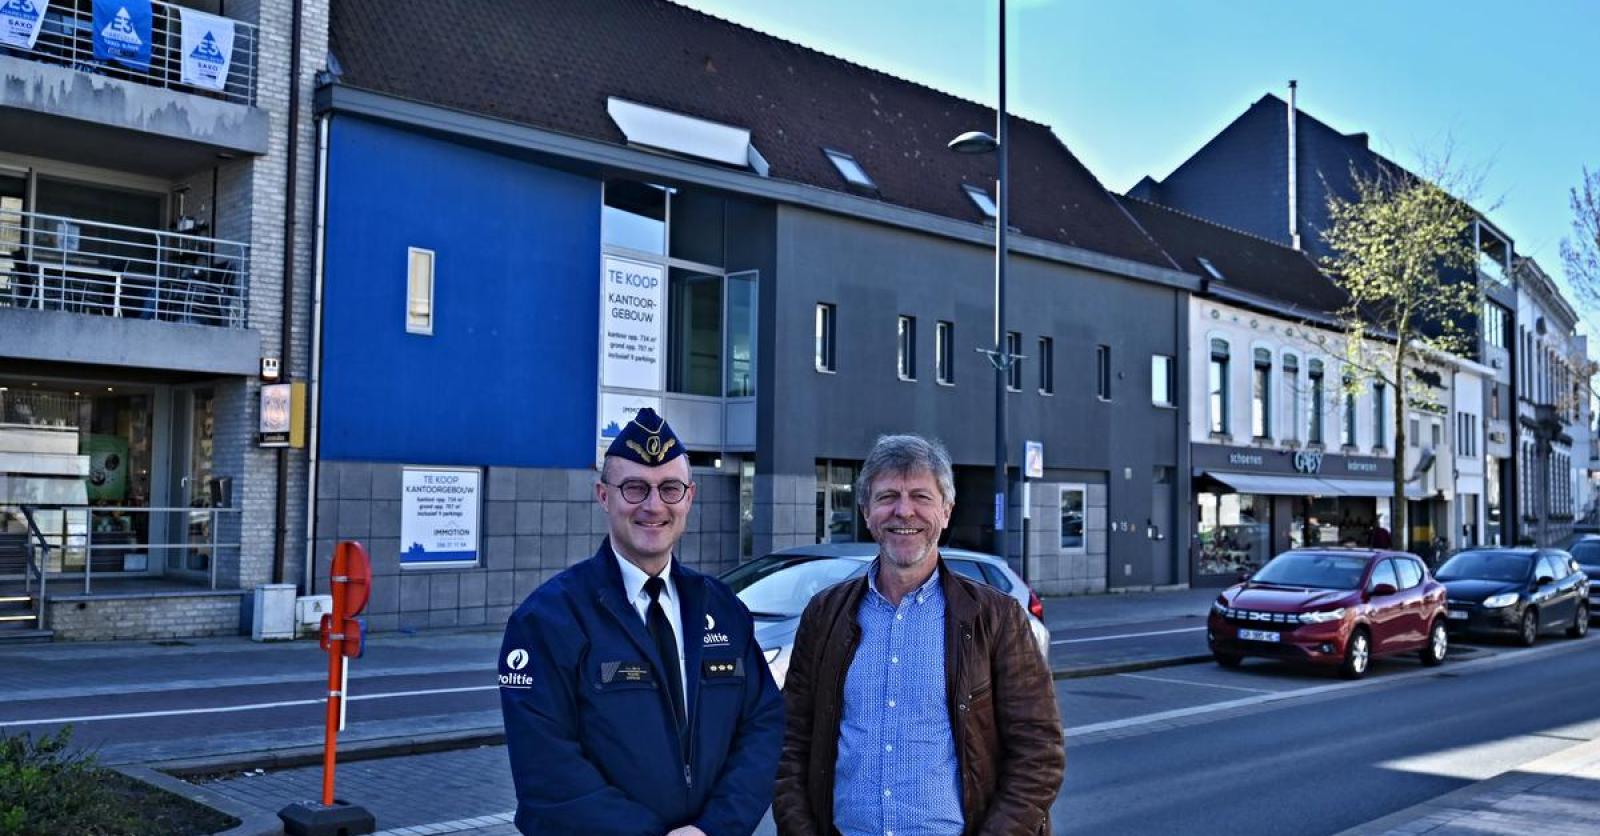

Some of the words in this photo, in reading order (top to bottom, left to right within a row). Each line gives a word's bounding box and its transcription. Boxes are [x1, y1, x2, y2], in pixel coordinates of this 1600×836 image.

[8, 19, 33, 29] SAXO
[111, 15, 133, 34] E3
[197, 39, 218, 56] E3
[608, 269, 624, 285] TE
[626, 272, 658, 289] KOOP
[608, 292, 657, 309] KANTOOR-
[611, 307, 654, 323] GEBOUW
[424, 475, 433, 484] TE
[436, 475, 459, 484] KOOP
[405, 485, 475, 494] KANTOORGEBOUW
[433, 528, 470, 536] IMMOTION
[703, 632, 729, 644] olitie
